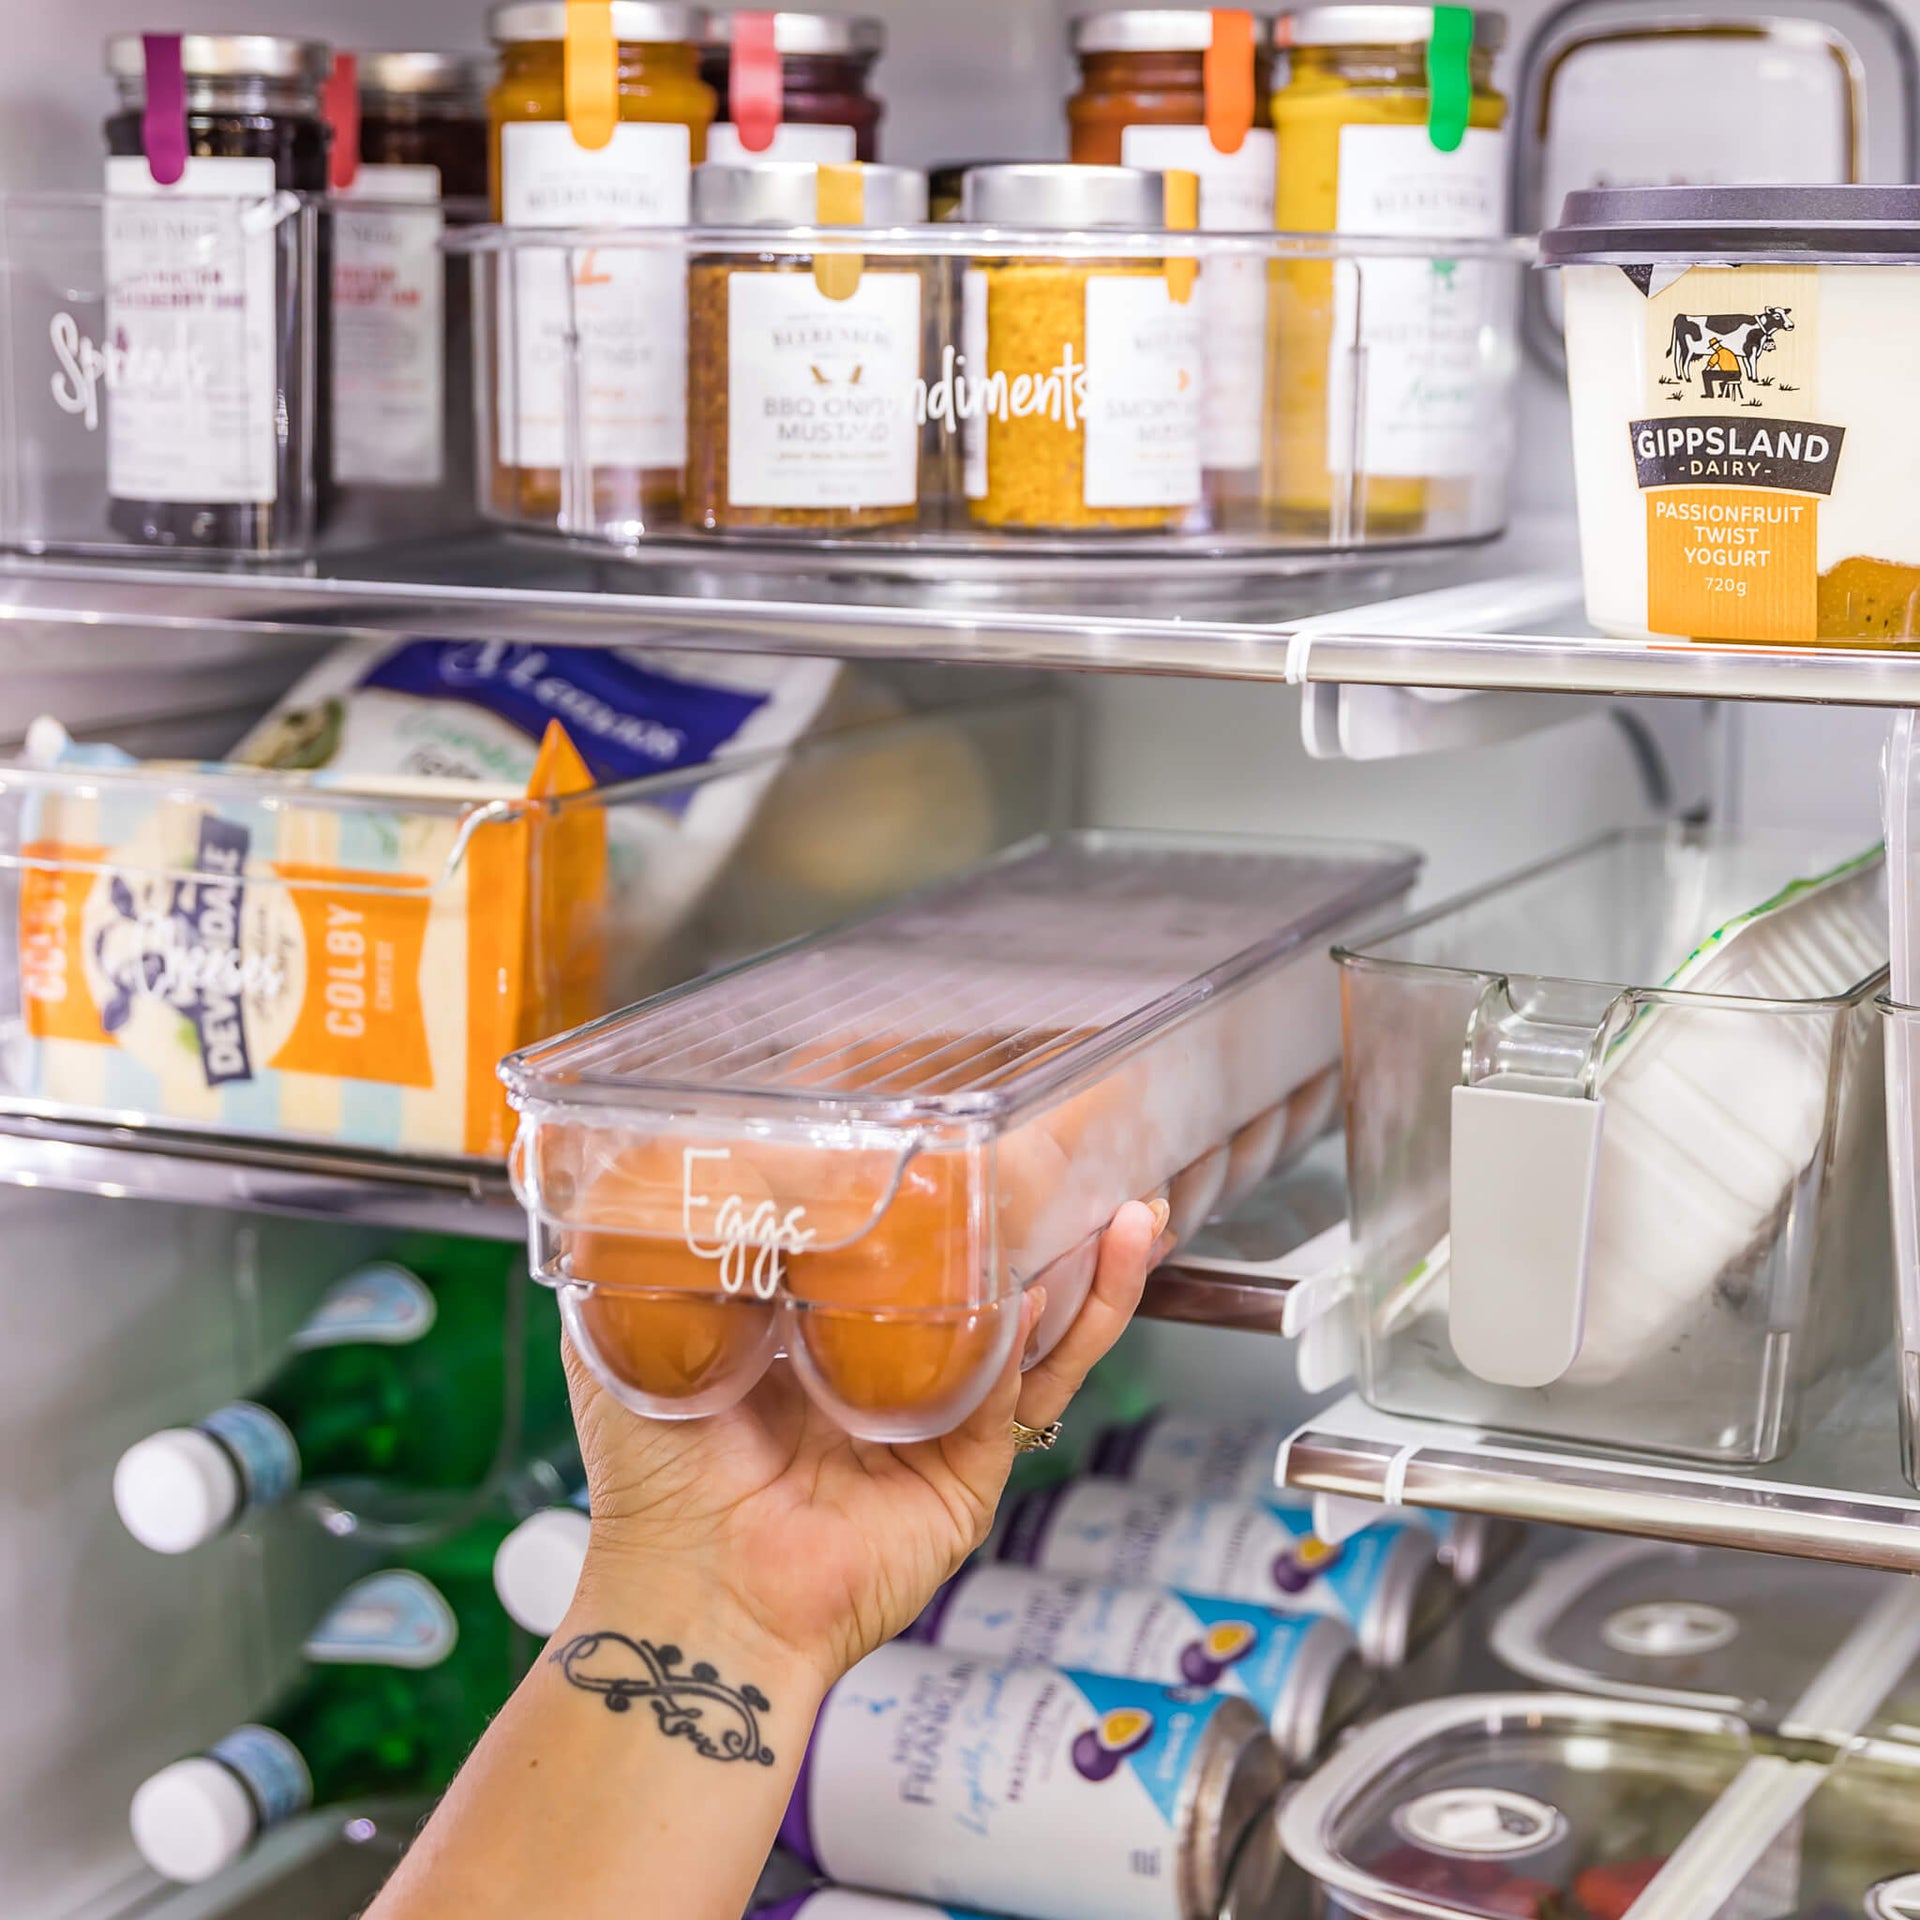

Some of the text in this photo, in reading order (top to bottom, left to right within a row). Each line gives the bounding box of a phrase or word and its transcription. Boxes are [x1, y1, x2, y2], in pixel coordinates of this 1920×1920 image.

[763, 397, 816, 418] BBQ
[1637, 426, 1830, 464] GIPPSLAND
[1655, 501, 1805, 524] PASSIONFRUIT
[1693, 526, 1760, 546] TWIST
[1684, 547, 1771, 567] YOGURT
[1704, 577, 1748, 597] 720g
[200, 842, 245, 1077] DEVDALE
[325, 902, 367, 1038] COLBY
[682, 1146, 817, 1300] Eggs
